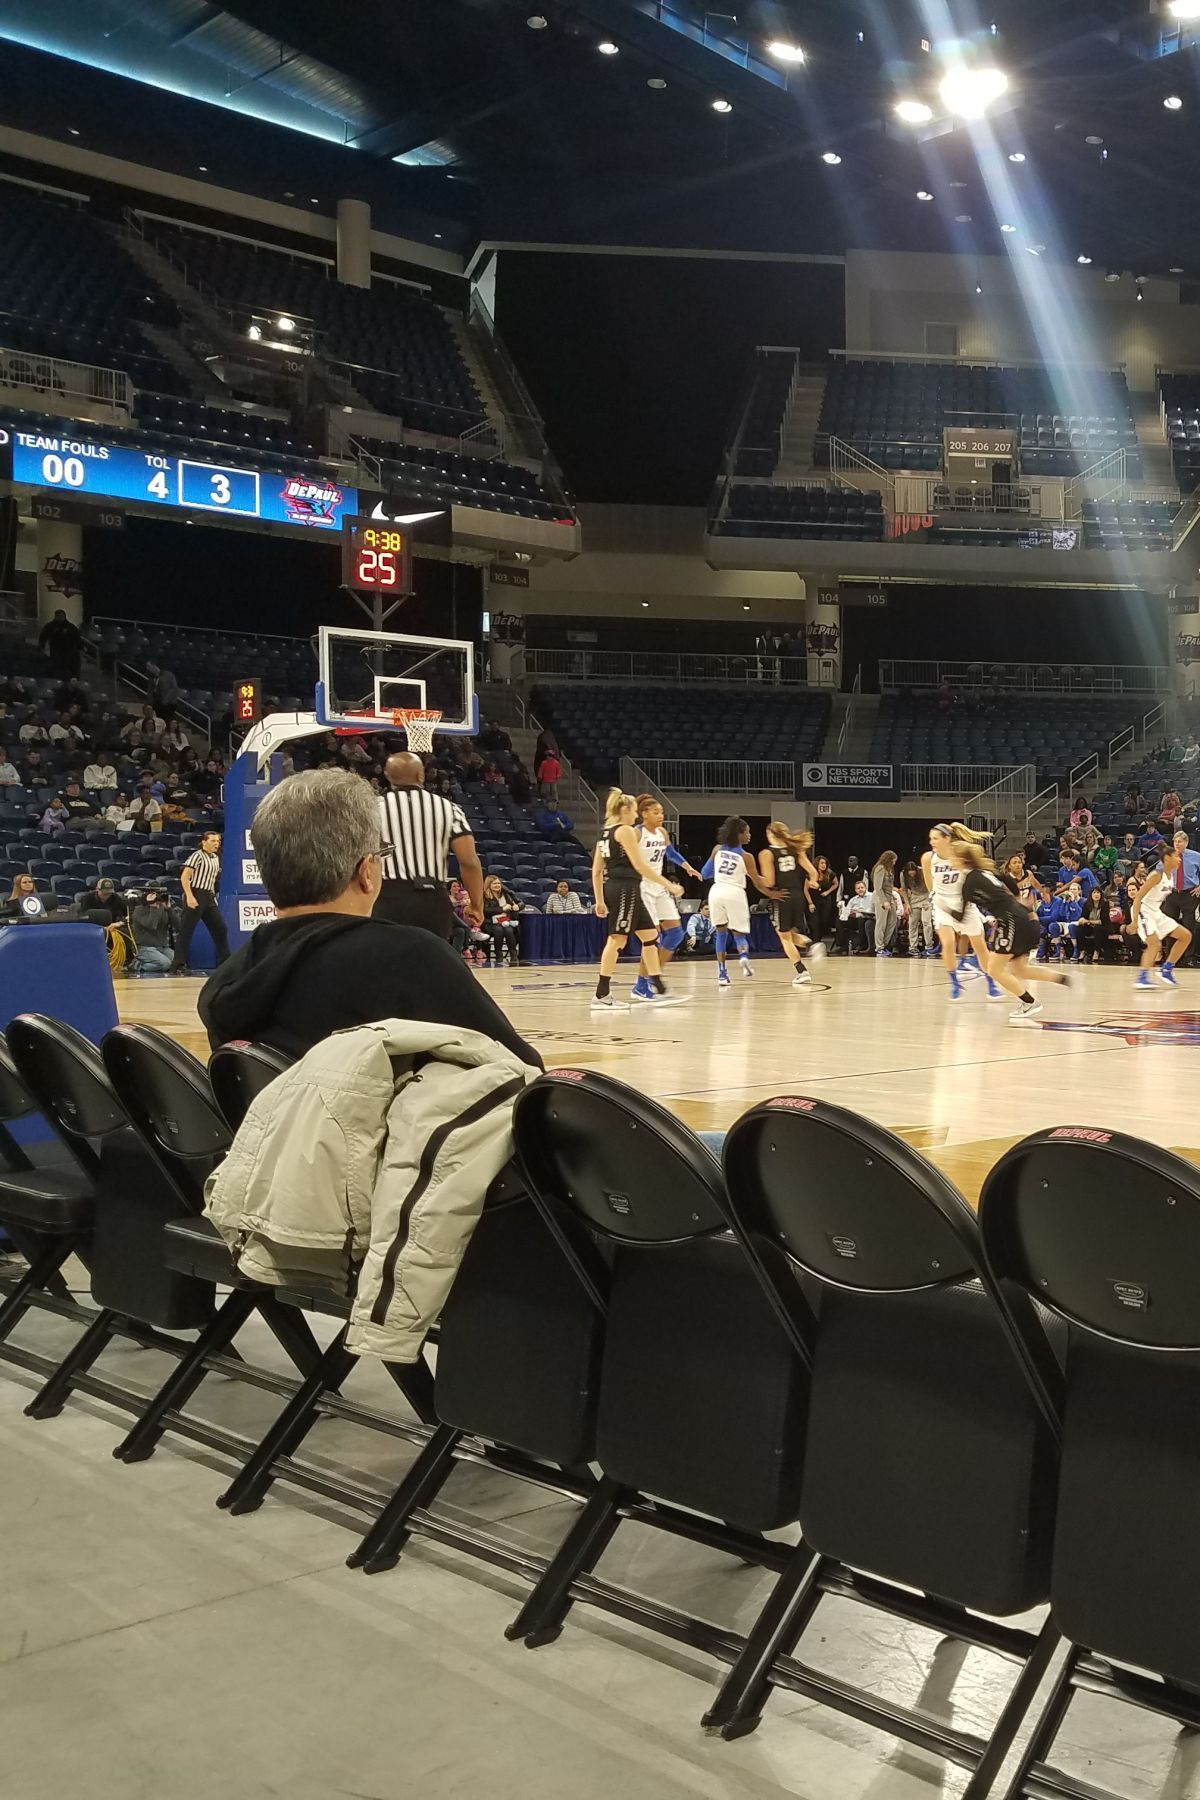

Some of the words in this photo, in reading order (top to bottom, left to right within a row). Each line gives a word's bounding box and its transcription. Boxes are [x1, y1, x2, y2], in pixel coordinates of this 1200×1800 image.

[17, 433, 58, 451] TEAM
[61, 440, 110, 459] FOULS
[949, 441, 967, 450] 205
[971, 442, 989, 451] 206
[994, 443, 1011, 452] 207
[42, 454, 84, 487] 00
[145, 454, 171, 471] TOL
[147, 471, 170, 500] 4
[210, 473, 232, 504] 3
[36, 504, 61, 518] 102
[99, 513, 122, 527] 103
[365, 529, 401, 551] 9:38
[359, 549, 396, 585] 25
[820, 593, 839, 603] 104
[867, 594, 885, 605] 105
[828, 767, 849, 776] CBS
[850, 767, 889, 777] SPORTS
[828, 775, 880, 784] NETWORK
[1047, 1128, 1113, 1143] DEPAUL
